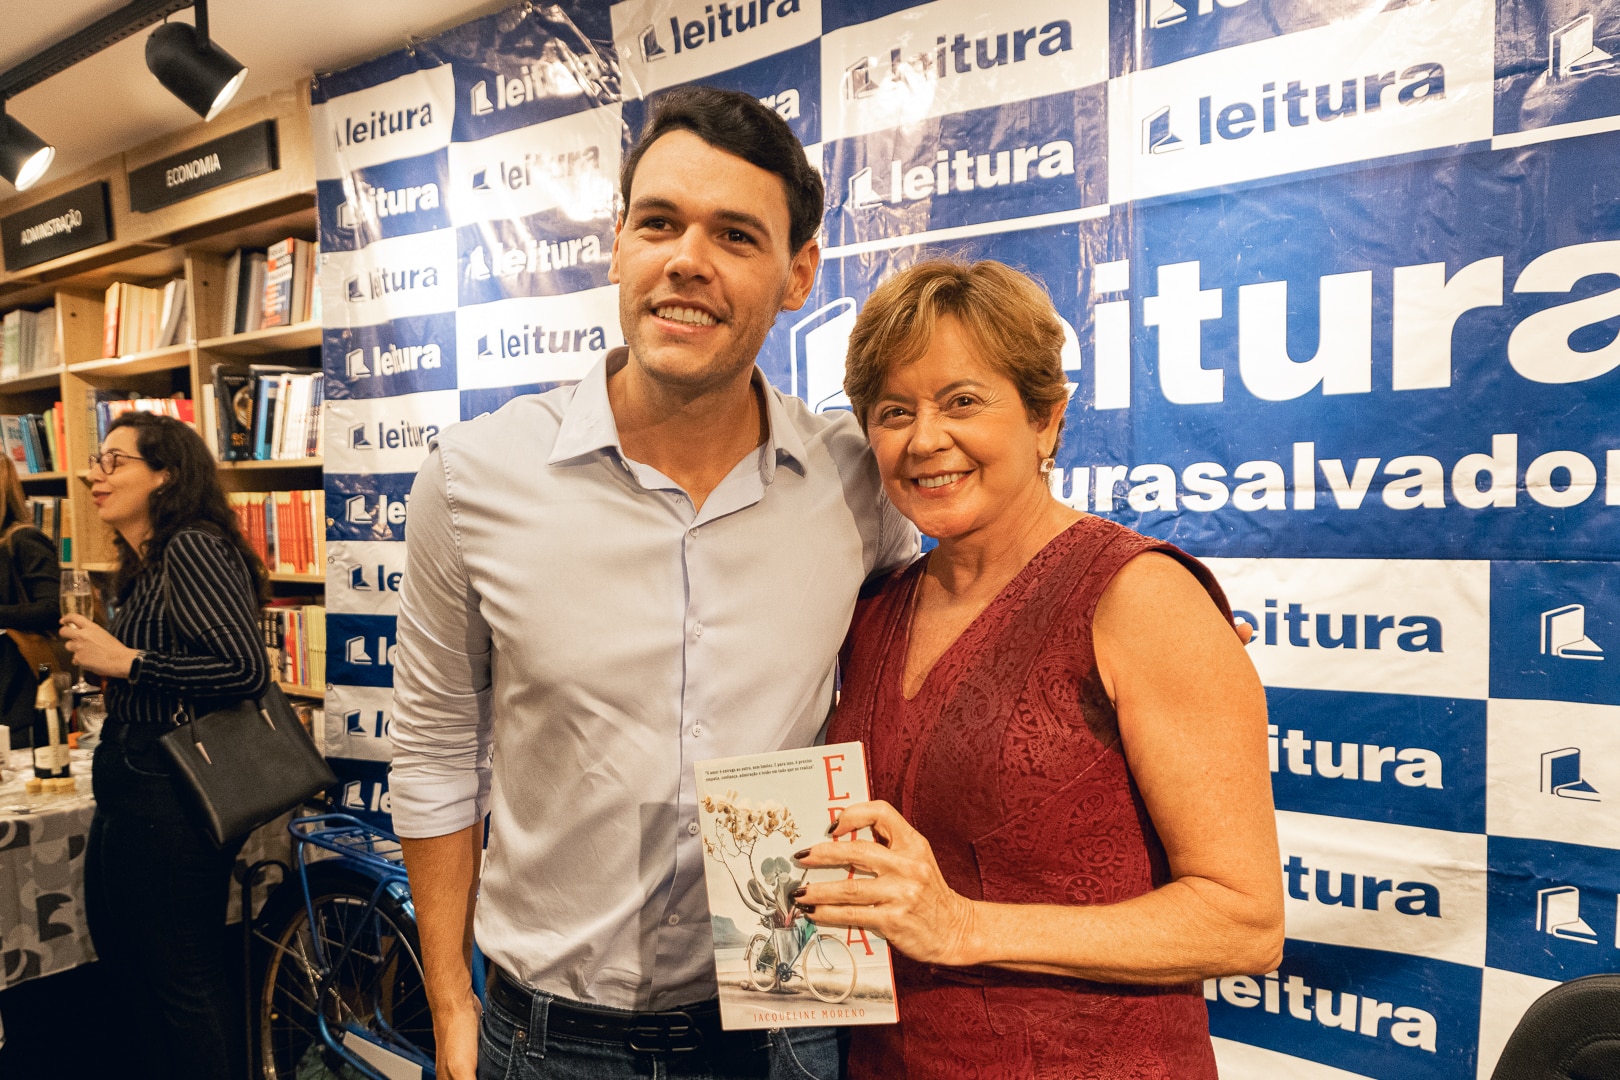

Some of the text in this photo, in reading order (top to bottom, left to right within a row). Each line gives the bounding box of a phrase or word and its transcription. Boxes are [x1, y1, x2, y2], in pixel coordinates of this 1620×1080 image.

[346, 102, 433, 146] leitura
[1199, 62, 1447, 145] leitura
[166, 153, 221, 187] ECONOMIA
[891, 140, 1075, 204] leitura
[491, 234, 601, 278] leitura
[500, 325, 606, 358] leitura
[1061, 240, 1620, 410] itura
[372, 343, 441, 377] leitura
[1050, 434, 1620, 512] urasalvado
[1268, 724, 1443, 790] itura
[1284, 855, 1441, 918] tura
[754, 1008, 865, 1022] JACQUELINE MORENO
